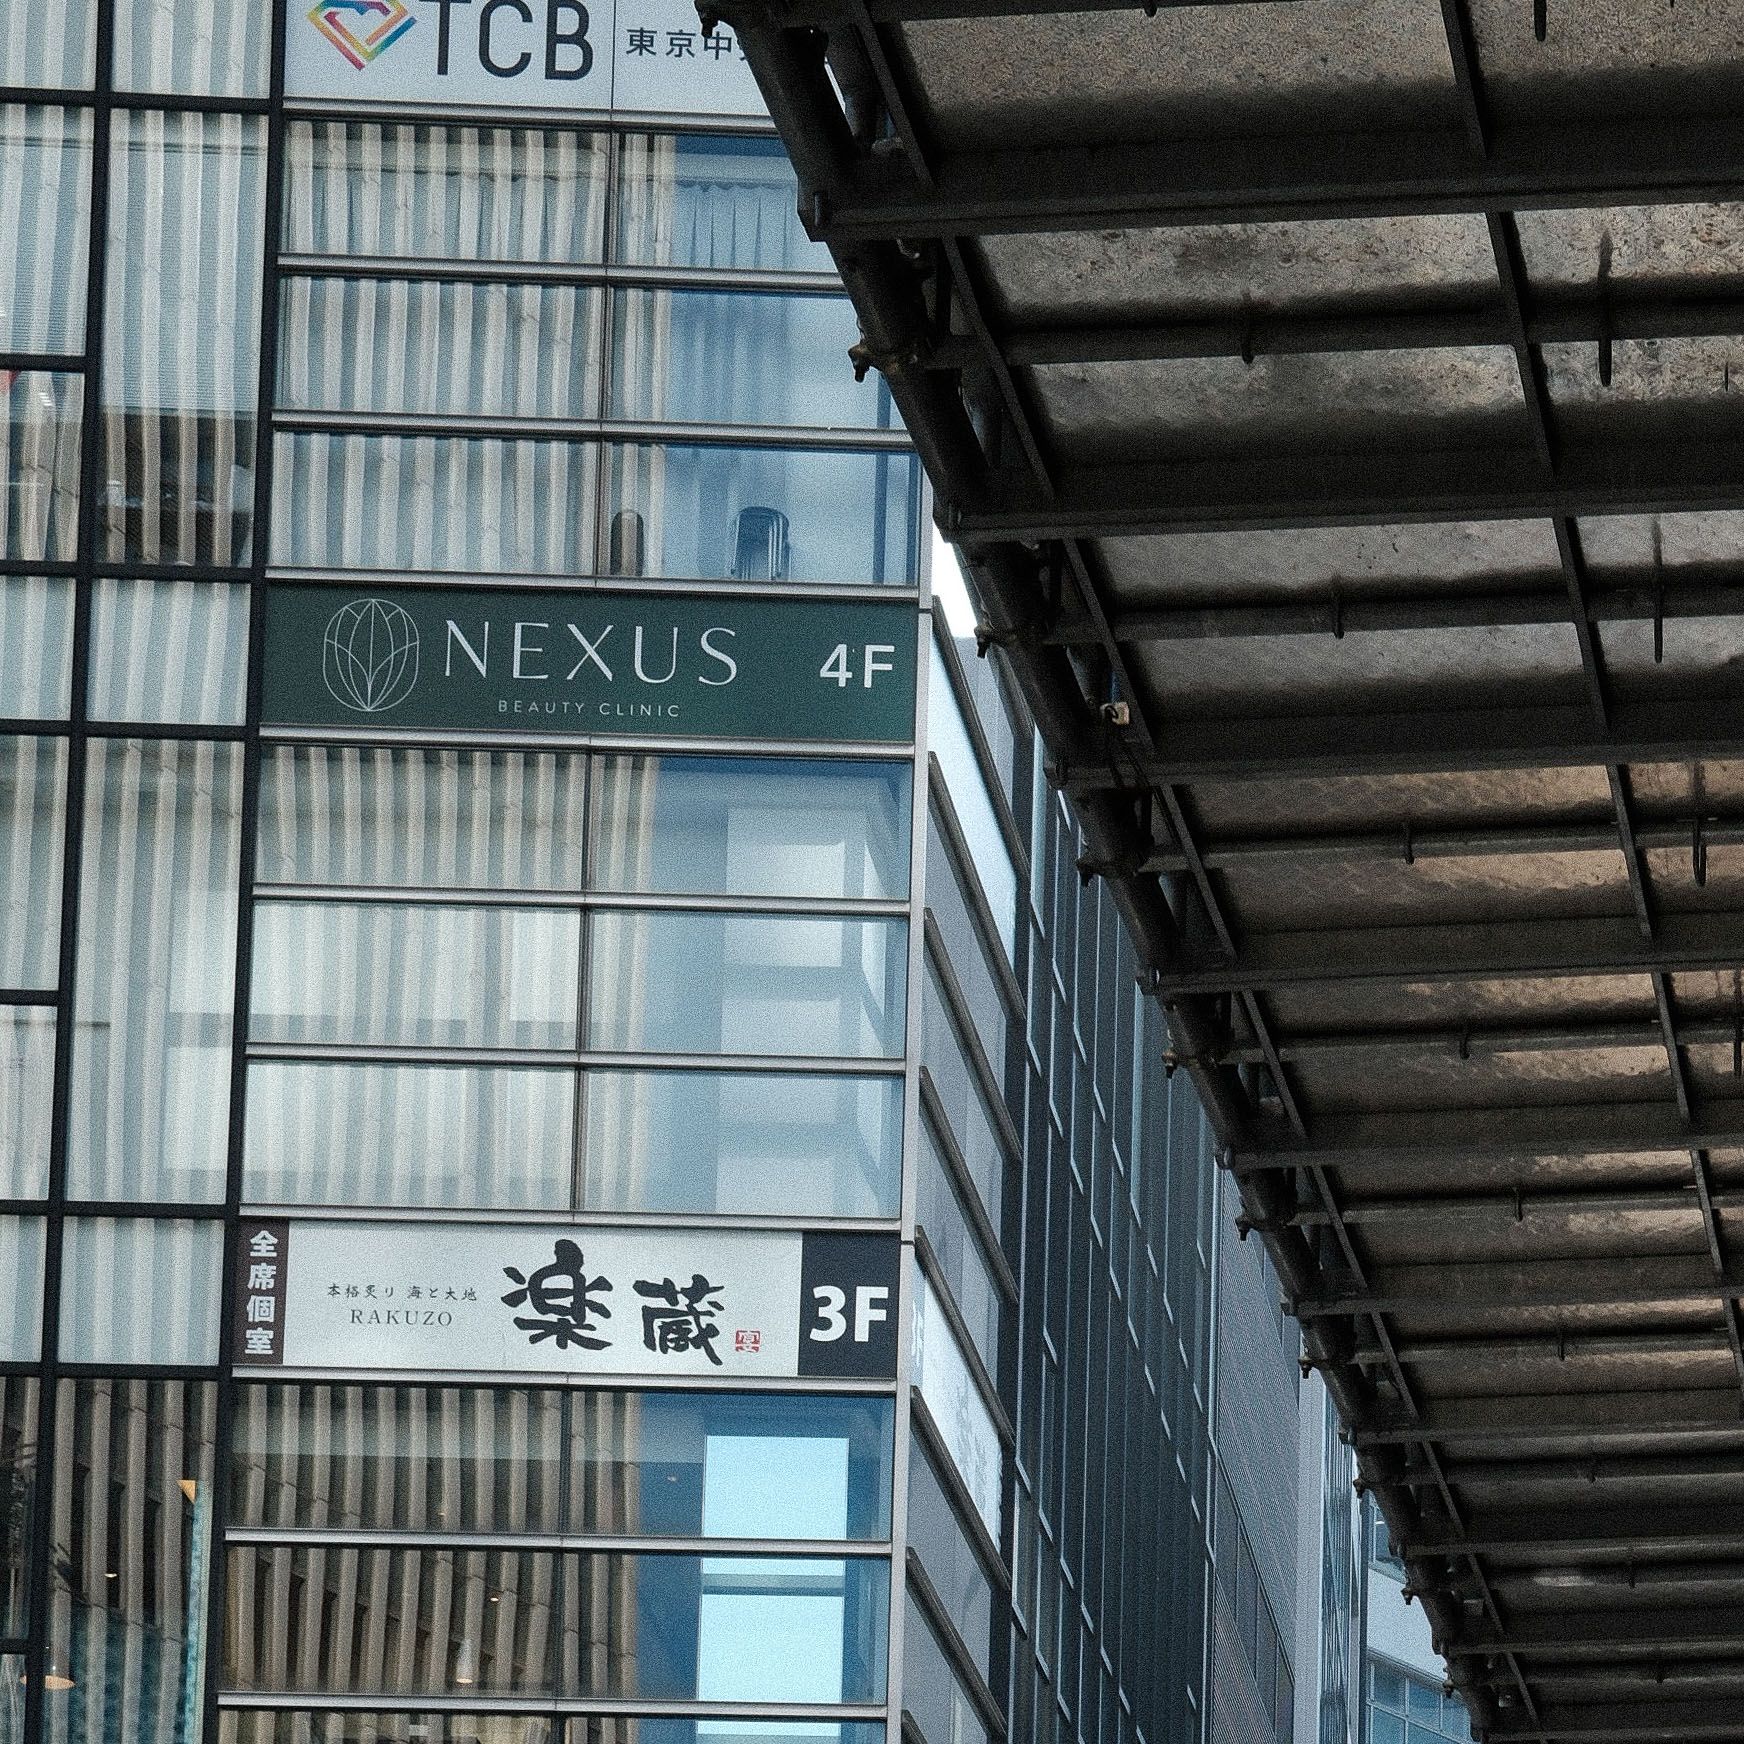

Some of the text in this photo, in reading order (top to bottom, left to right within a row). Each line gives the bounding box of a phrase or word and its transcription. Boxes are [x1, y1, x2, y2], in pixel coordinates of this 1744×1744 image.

[417, 0, 593, 80] TCB
[626, 27, 746, 61] 東京中
[445, 619, 738, 685] NEXUS
[819, 643, 896, 688] 4F
[498, 700, 681, 717] BEAUTY CLINIC
[244, 1230, 278, 1356] 全席個室
[350, 1309, 453, 1326] RAKUZO
[500, 1239, 725, 1366] 楽蔵
[809, 1285, 889, 1343] 3F
